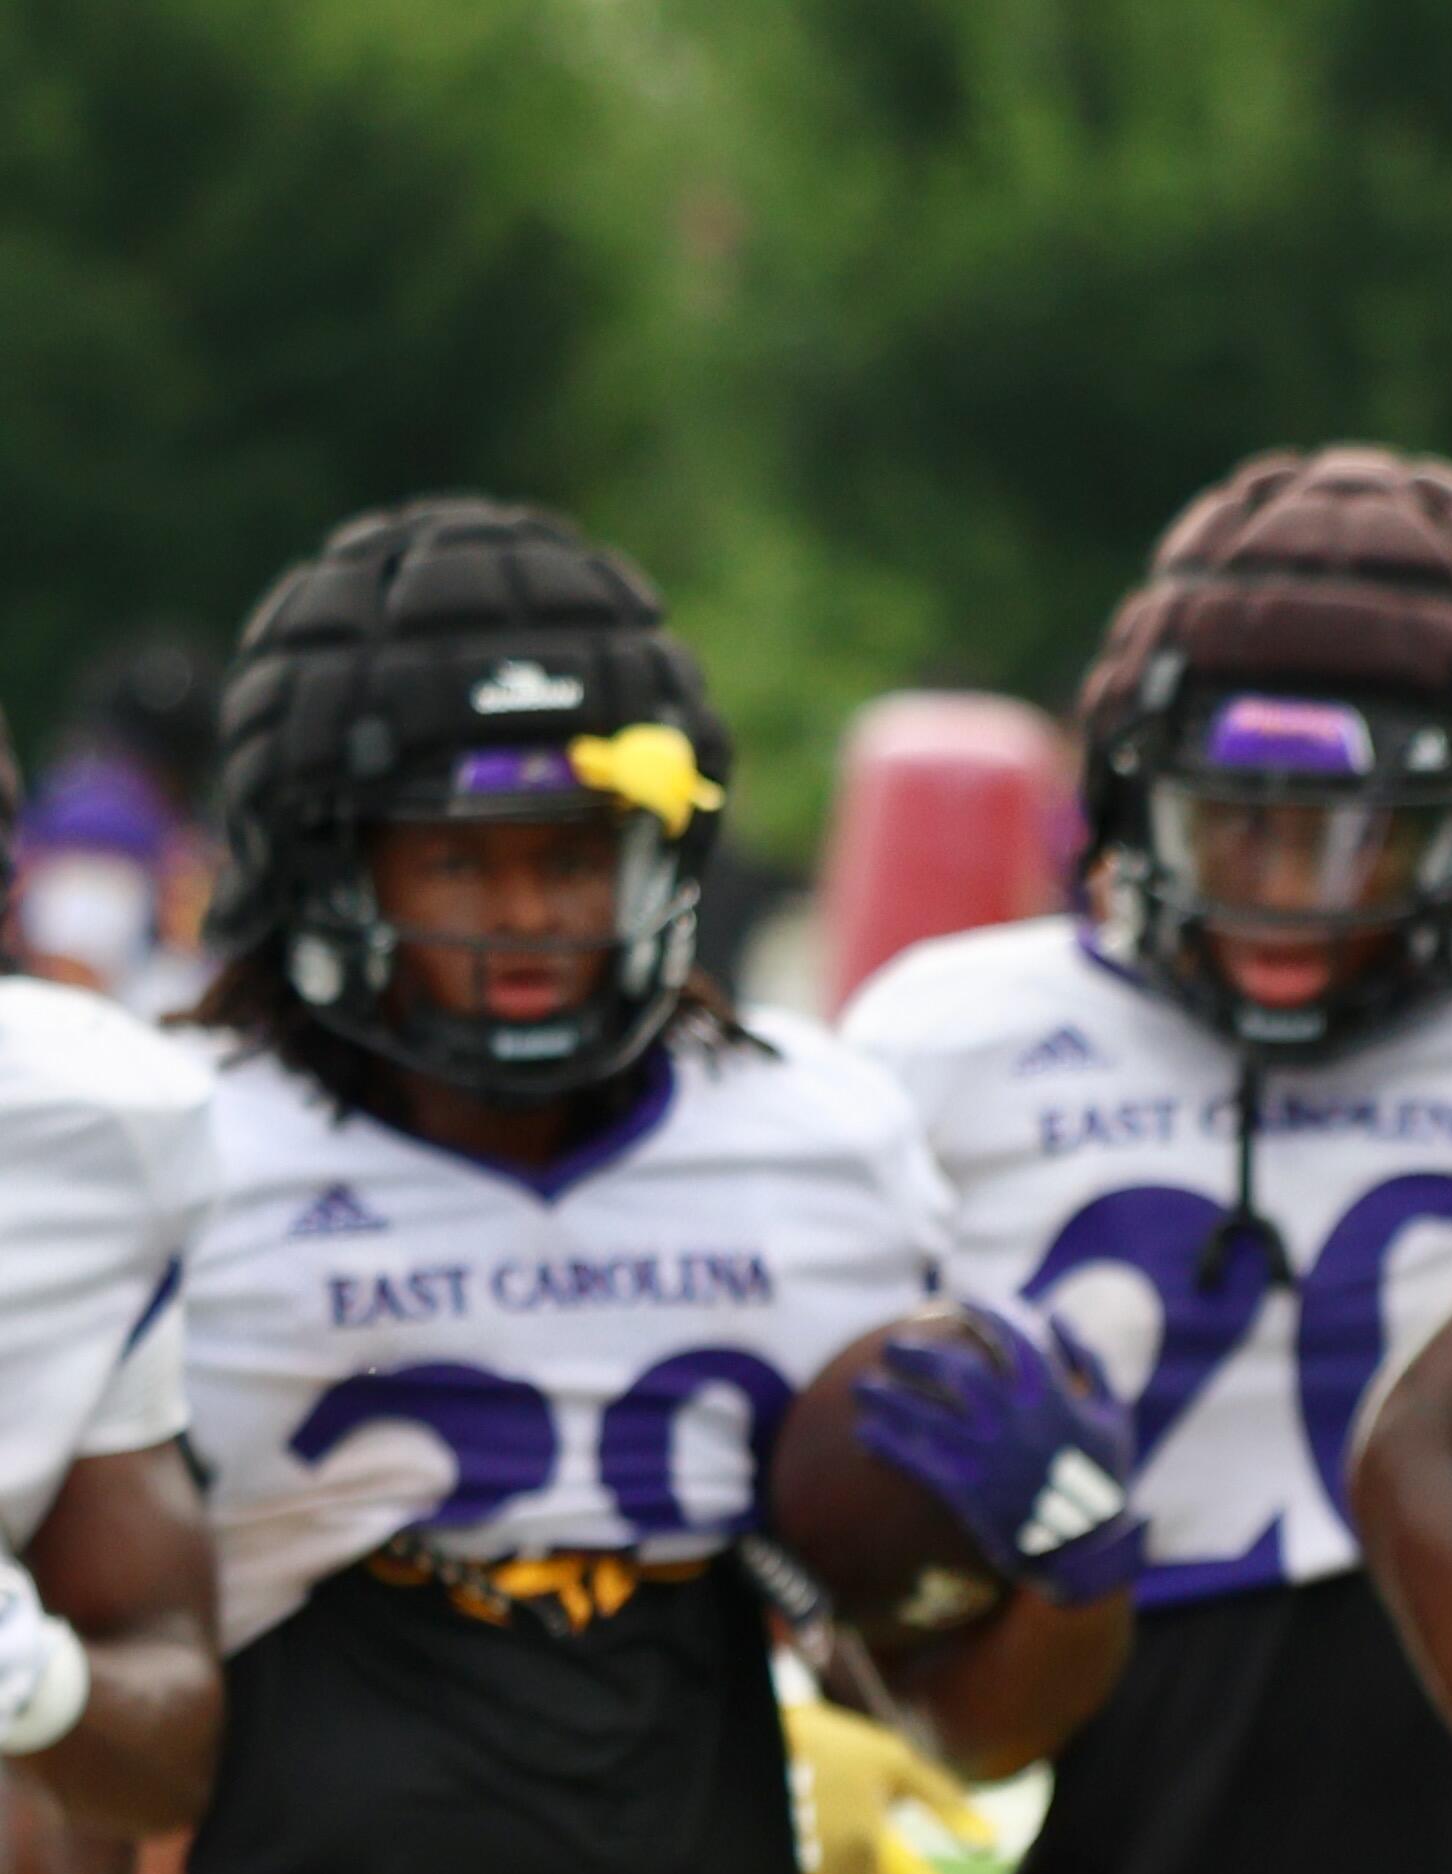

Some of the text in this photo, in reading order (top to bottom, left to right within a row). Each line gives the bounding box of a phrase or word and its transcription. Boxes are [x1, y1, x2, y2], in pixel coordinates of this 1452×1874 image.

[1040, 1101, 1176, 1155] EAST
[328, 1252, 776, 1326] EAST CAROLINA
